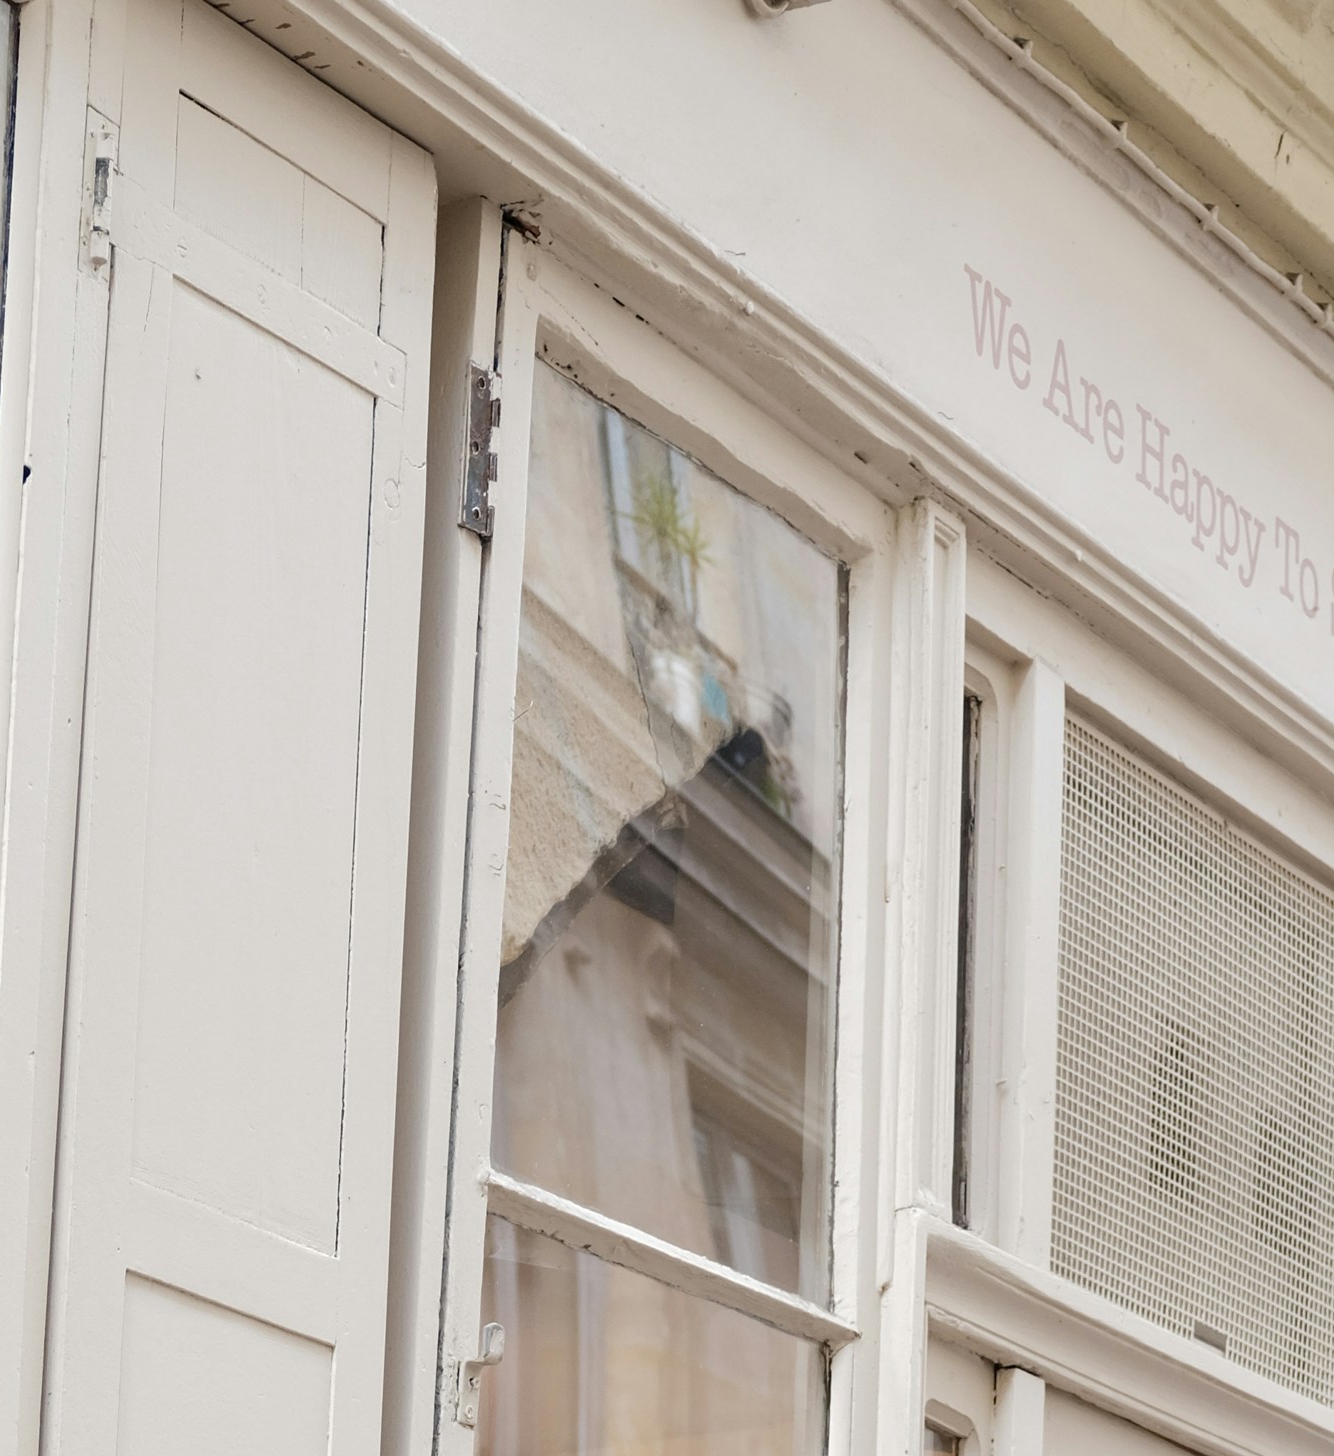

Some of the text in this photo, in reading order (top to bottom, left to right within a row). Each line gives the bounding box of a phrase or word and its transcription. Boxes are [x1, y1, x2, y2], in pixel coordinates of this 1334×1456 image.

[964, 263, 1031, 391] We
[1042, 338, 1126, 464] Are
[1135, 403, 1267, 589] Happy
[1275, 516, 1320, 619] To
